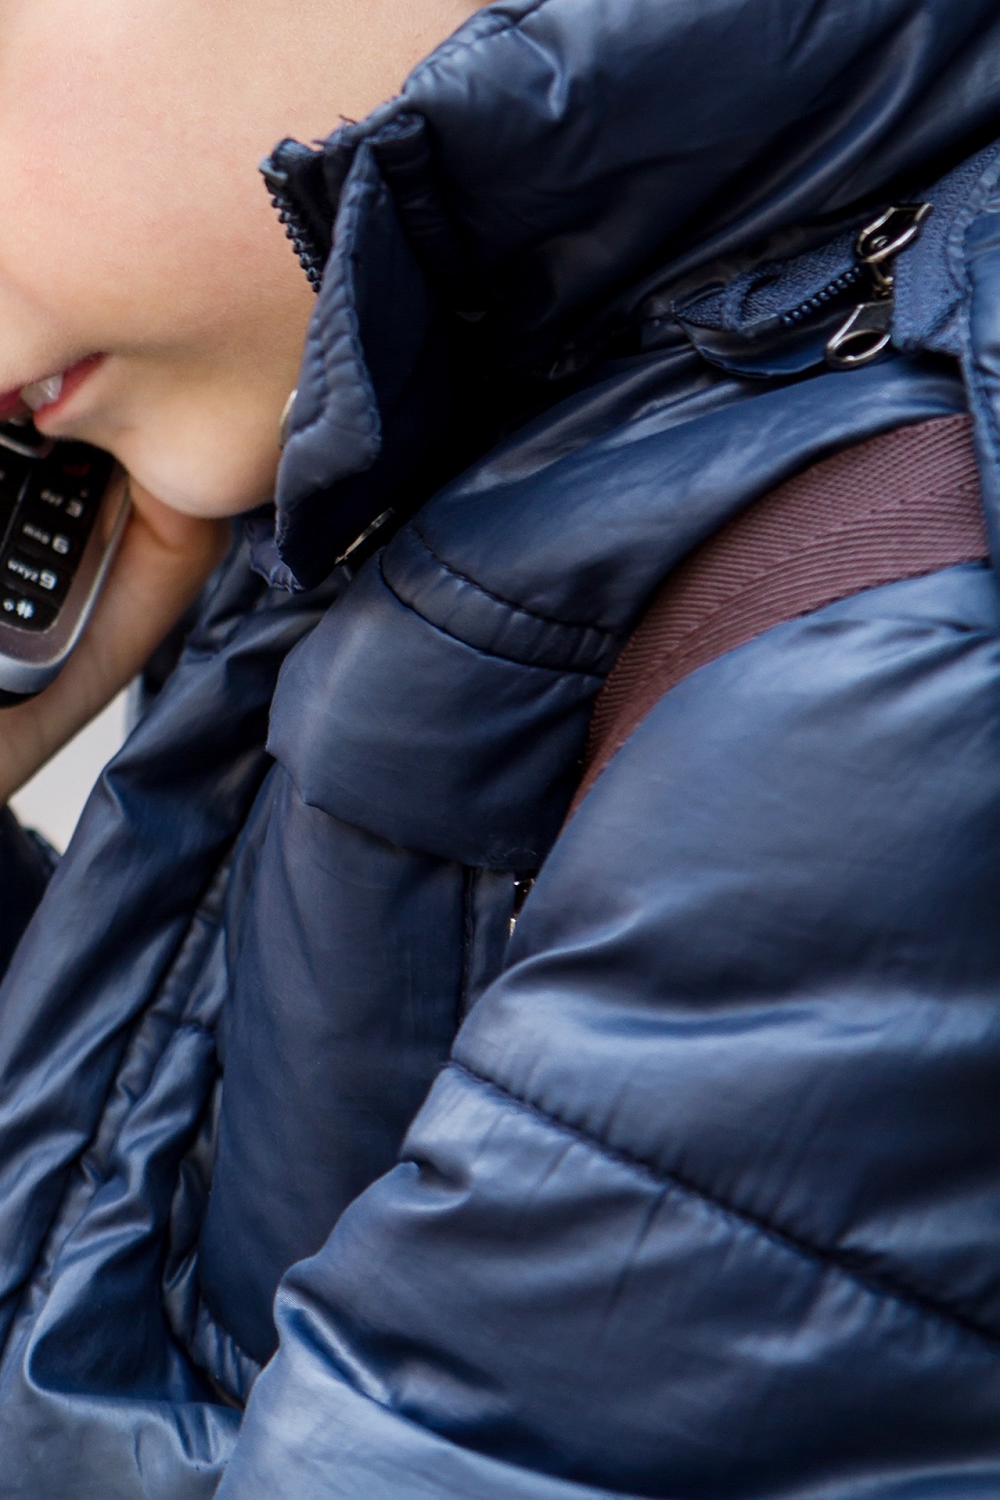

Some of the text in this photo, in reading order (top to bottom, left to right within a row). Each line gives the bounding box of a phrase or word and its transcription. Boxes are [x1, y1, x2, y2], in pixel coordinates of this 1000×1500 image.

[52, 534, 70, 555] 6
[7, 558, 57, 591] wxyz 9
